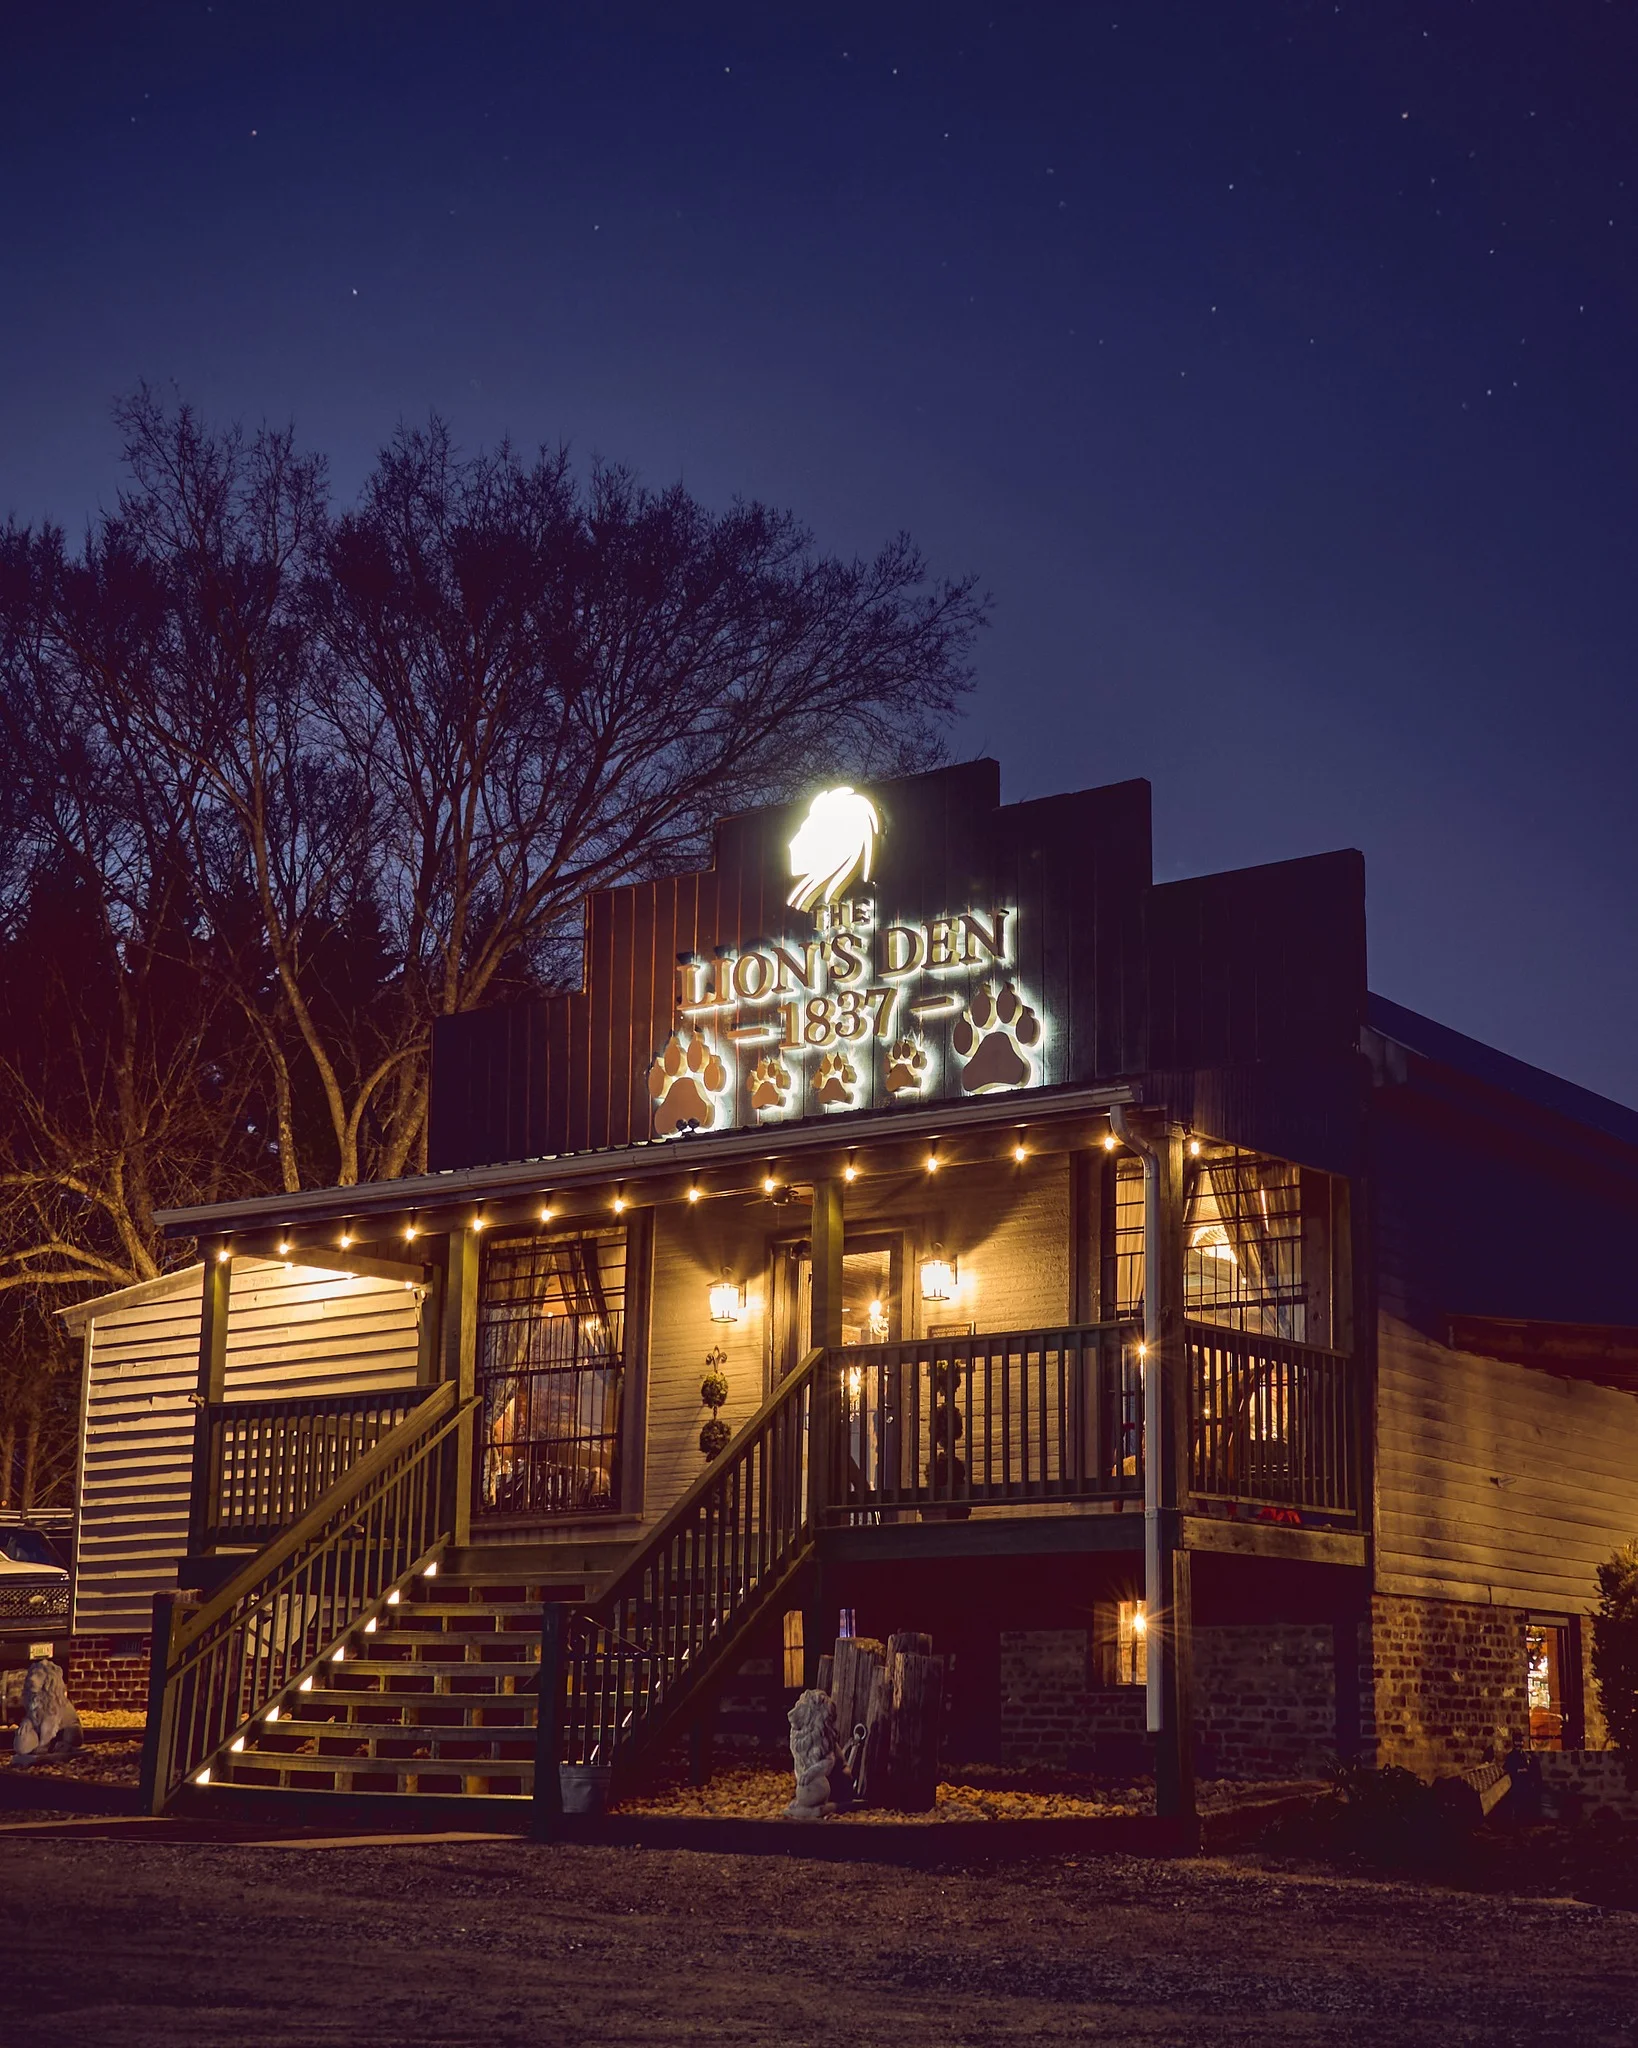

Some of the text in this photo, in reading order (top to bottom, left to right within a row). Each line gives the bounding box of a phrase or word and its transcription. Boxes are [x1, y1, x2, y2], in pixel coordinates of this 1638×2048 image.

[812, 900, 870, 931] THE
[676, 909, 1009, 1010] LION'S DEN
